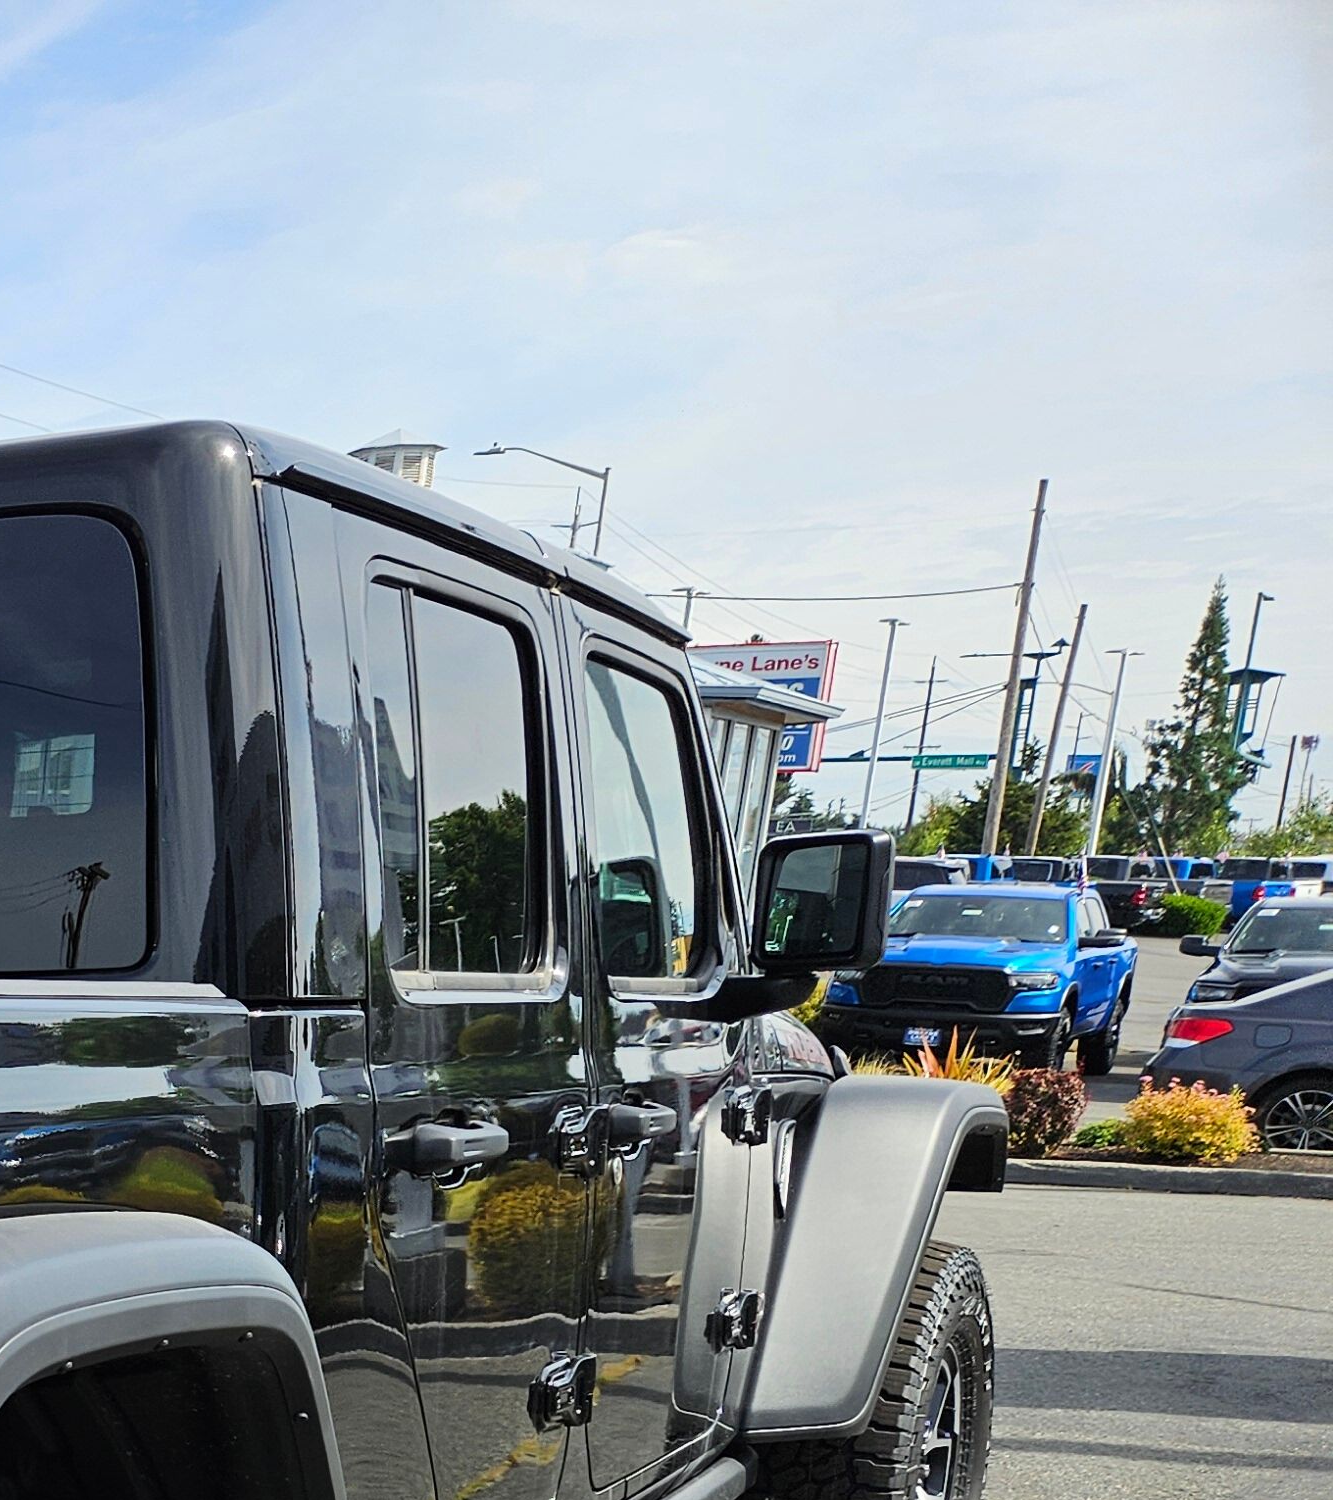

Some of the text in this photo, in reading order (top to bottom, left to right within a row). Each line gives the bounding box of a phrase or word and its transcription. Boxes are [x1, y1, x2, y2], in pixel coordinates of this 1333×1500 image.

[751, 654, 819, 671] Lane's
[921, 756, 952, 766] Everett
[956, 756, 975, 766] Mall
